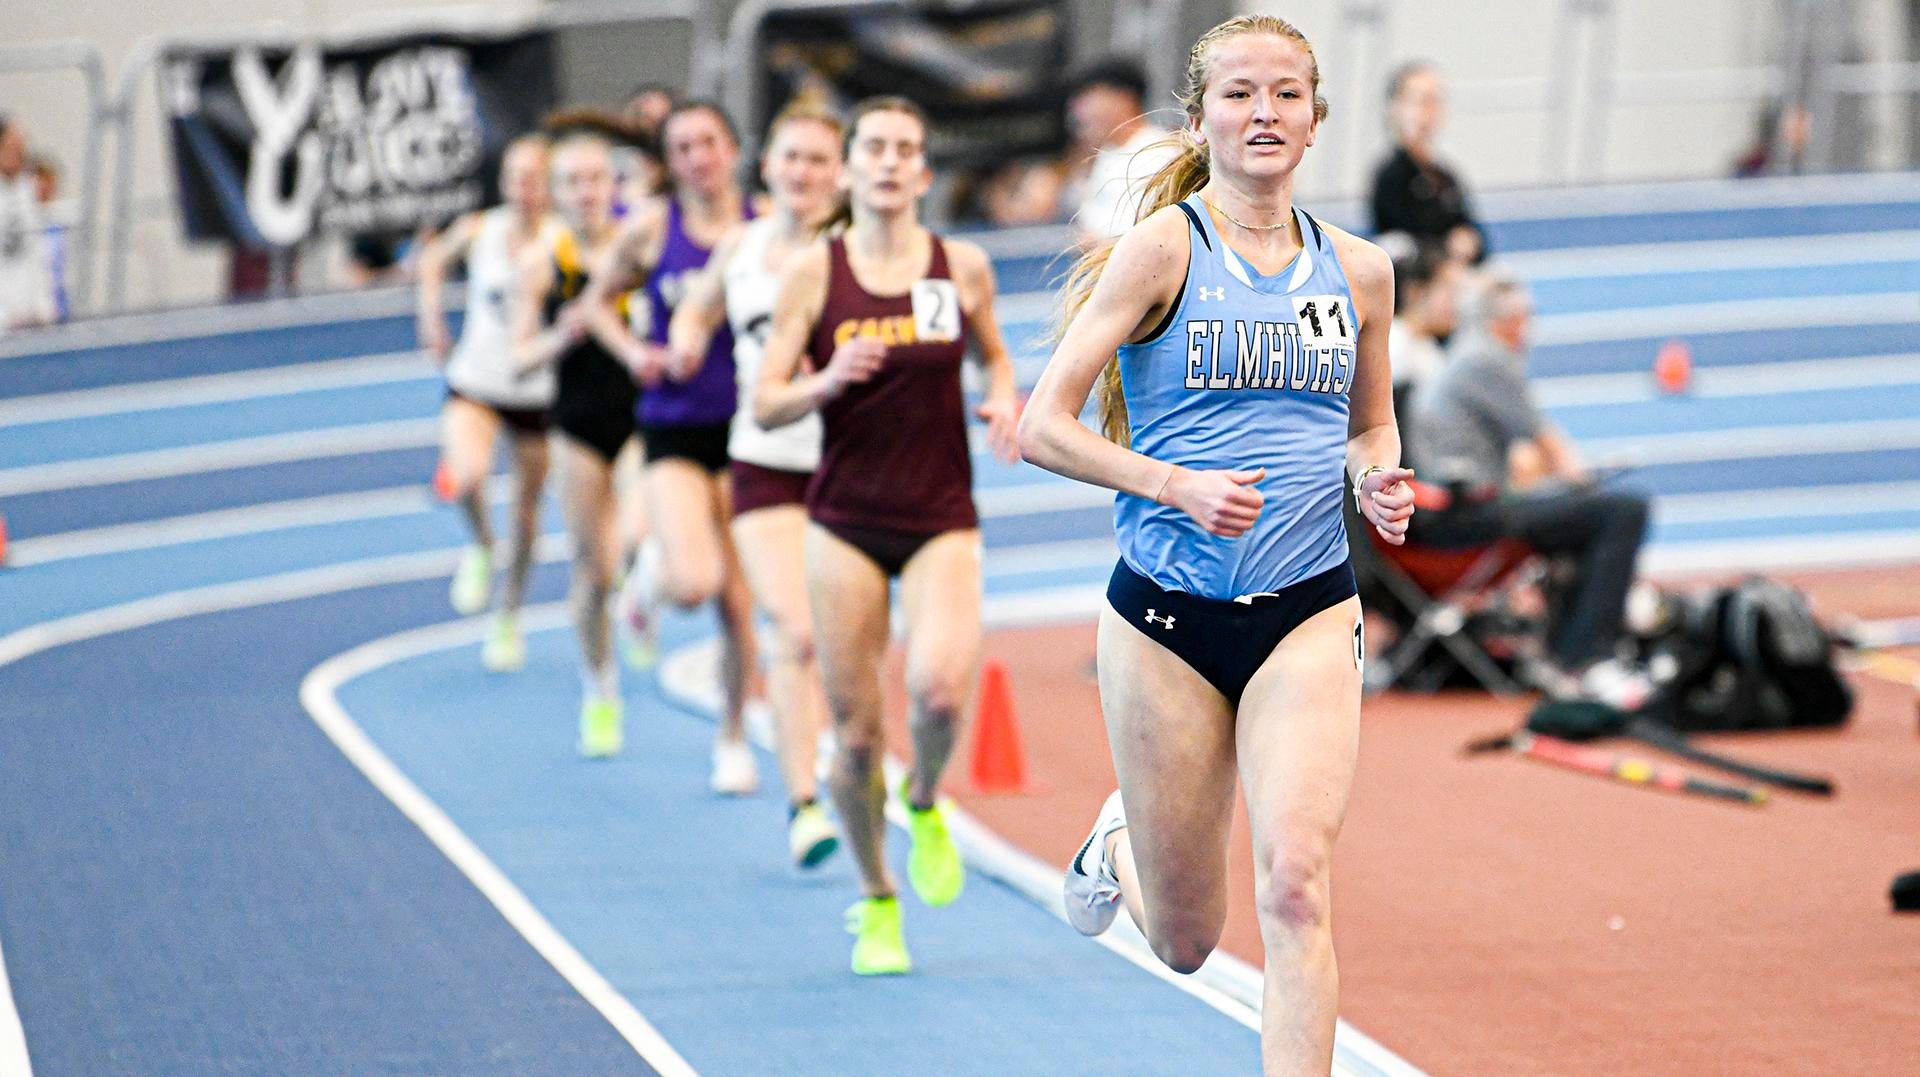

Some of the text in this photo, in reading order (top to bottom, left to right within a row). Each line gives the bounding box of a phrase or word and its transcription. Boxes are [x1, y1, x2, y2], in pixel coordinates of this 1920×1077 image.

[927, 284, 946, 330] 2
[1299, 301, 1347, 337] 11
[1184, 320, 1354, 395] ELMHURS
